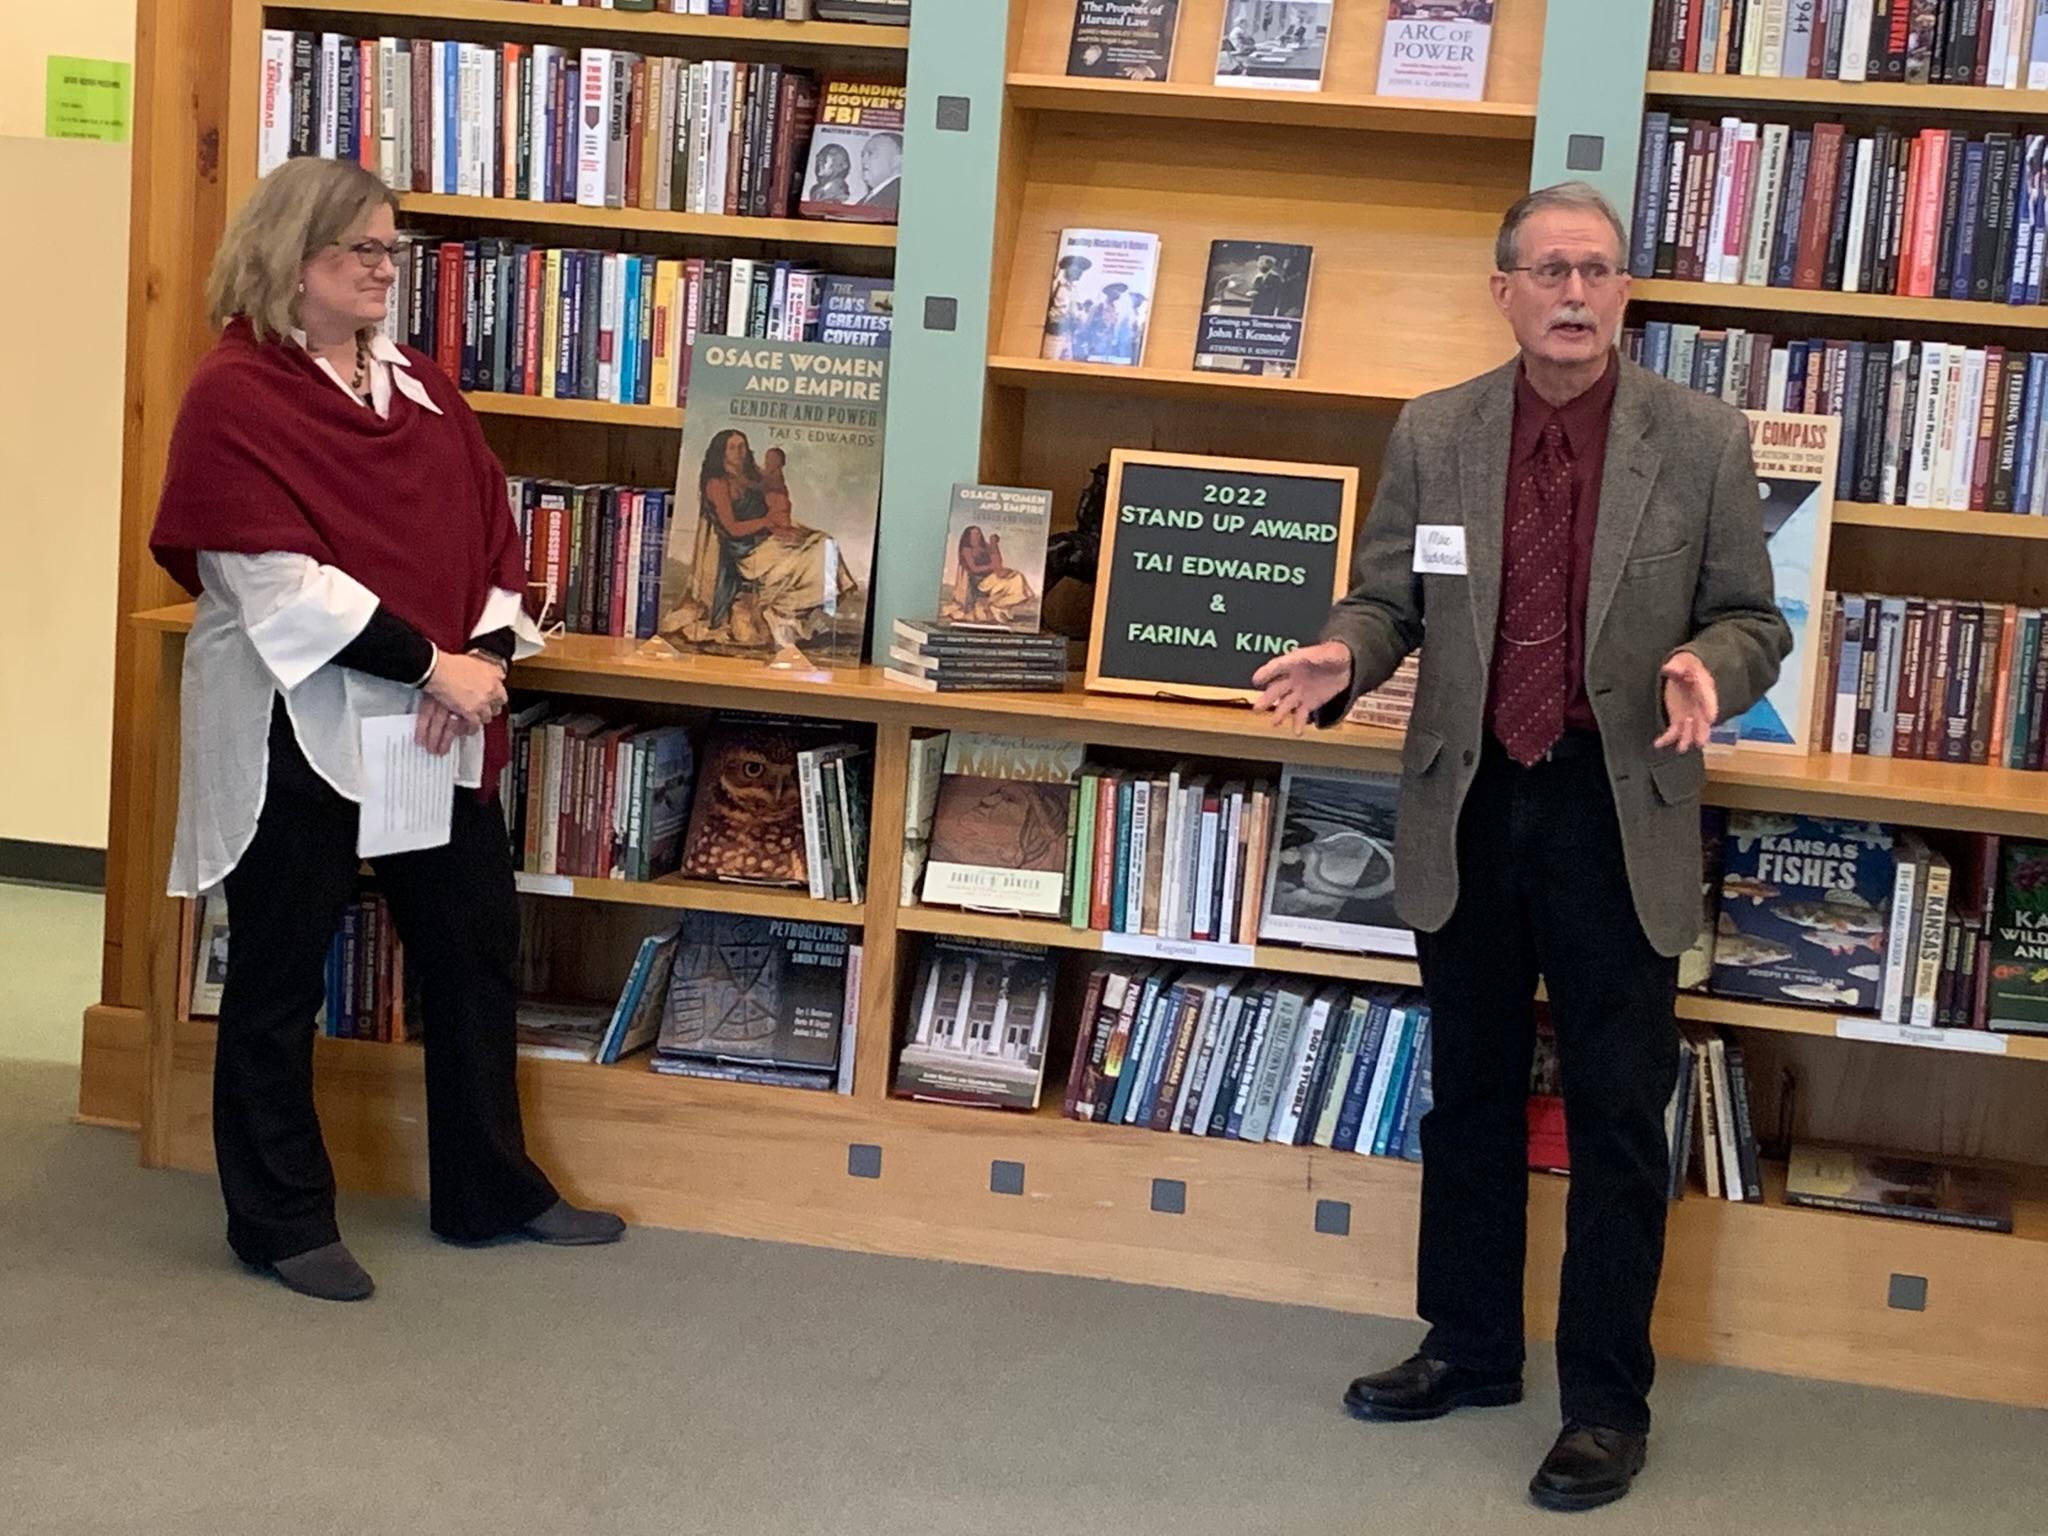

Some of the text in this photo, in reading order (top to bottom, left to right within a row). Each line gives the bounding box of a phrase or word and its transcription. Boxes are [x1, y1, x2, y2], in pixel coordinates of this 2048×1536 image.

[1079, 14, 1150, 27] Harvard Law
[1082, 1, 1164, 16] The Prophet of
[1399, 24, 1472, 43] ARC OF
[1392, 42, 1475, 62] POWER
[265, 59, 277, 128] LENINGRAD
[611, 61, 624, 141] BIG SKY RIVERS
[826, 94, 904, 110] HOOVER'S
[829, 82, 907, 98] BRANDING
[822, 105, 862, 125] FBI
[1648, 133, 1664, 194] DOMINION
[1993, 150, 2005, 180] ELLEN
[1920, 136, 1945, 267] Eisenhower's Heart Attack
[1987, 196, 2000, 228] EDITH
[1644, 208, 1657, 249] BEARS
[485, 259, 497, 273] The
[484, 274, 496, 315] Cambodian
[832, 283, 853, 294] THE
[687, 281, 699, 346] CHEROKEE KID
[828, 296, 865, 312] CIA'S
[826, 313, 893, 331] GREATEST
[1209, 316, 1241, 328] Coming
[560, 297, 571, 373] CARBON NATION
[823, 328, 879, 346] COVERT
[1207, 327, 1292, 345] John F. Kennedy
[705, 346, 885, 379] OSAGE WOMEN
[1838, 350, 1847, 368] THE
[745, 375, 881, 401] AND EMPIRE
[1835, 370, 1845, 395] FATE
[729, 399, 878, 427] GENDER AND POWER
[1927, 398, 1937, 421] and
[1762, 420, 1827, 450] COMPASS
[2000, 374, 2024, 471] FEEDING VICTORY
[768, 426, 791, 440] TAI
[807, 429, 876, 447] EDWARDS
[1921, 424, 1935, 471] Reagan
[960, 489, 1046, 505] OSAGE WOMEN
[1203, 484, 1267, 507] 2022
[979, 502, 1044, 515] AND EMPIRE
[547, 511, 561, 562] COLOSSUS
[1120, 505, 1338, 543] STAND UP AWARD
[1133, 551, 1306, 585] TAI EDWARDS
[1209, 594, 1226, 613] &
[1127, 622, 1300, 655] FARINA KING
[956, 748, 1071, 782] KANSAS
[1759, 835, 1859, 860] KANSAS
[1757, 852, 1857, 890] FISHES
[769, 921, 848, 942] PETROGLYPHS
[1921, 896, 1945, 961] KANSAS
[798, 941, 813, 952] THE
[820, 955, 843, 967] HILLS
[1307, 1029, 1323, 1052] SOD
[1290, 1066, 1312, 1119] STUBBLE
